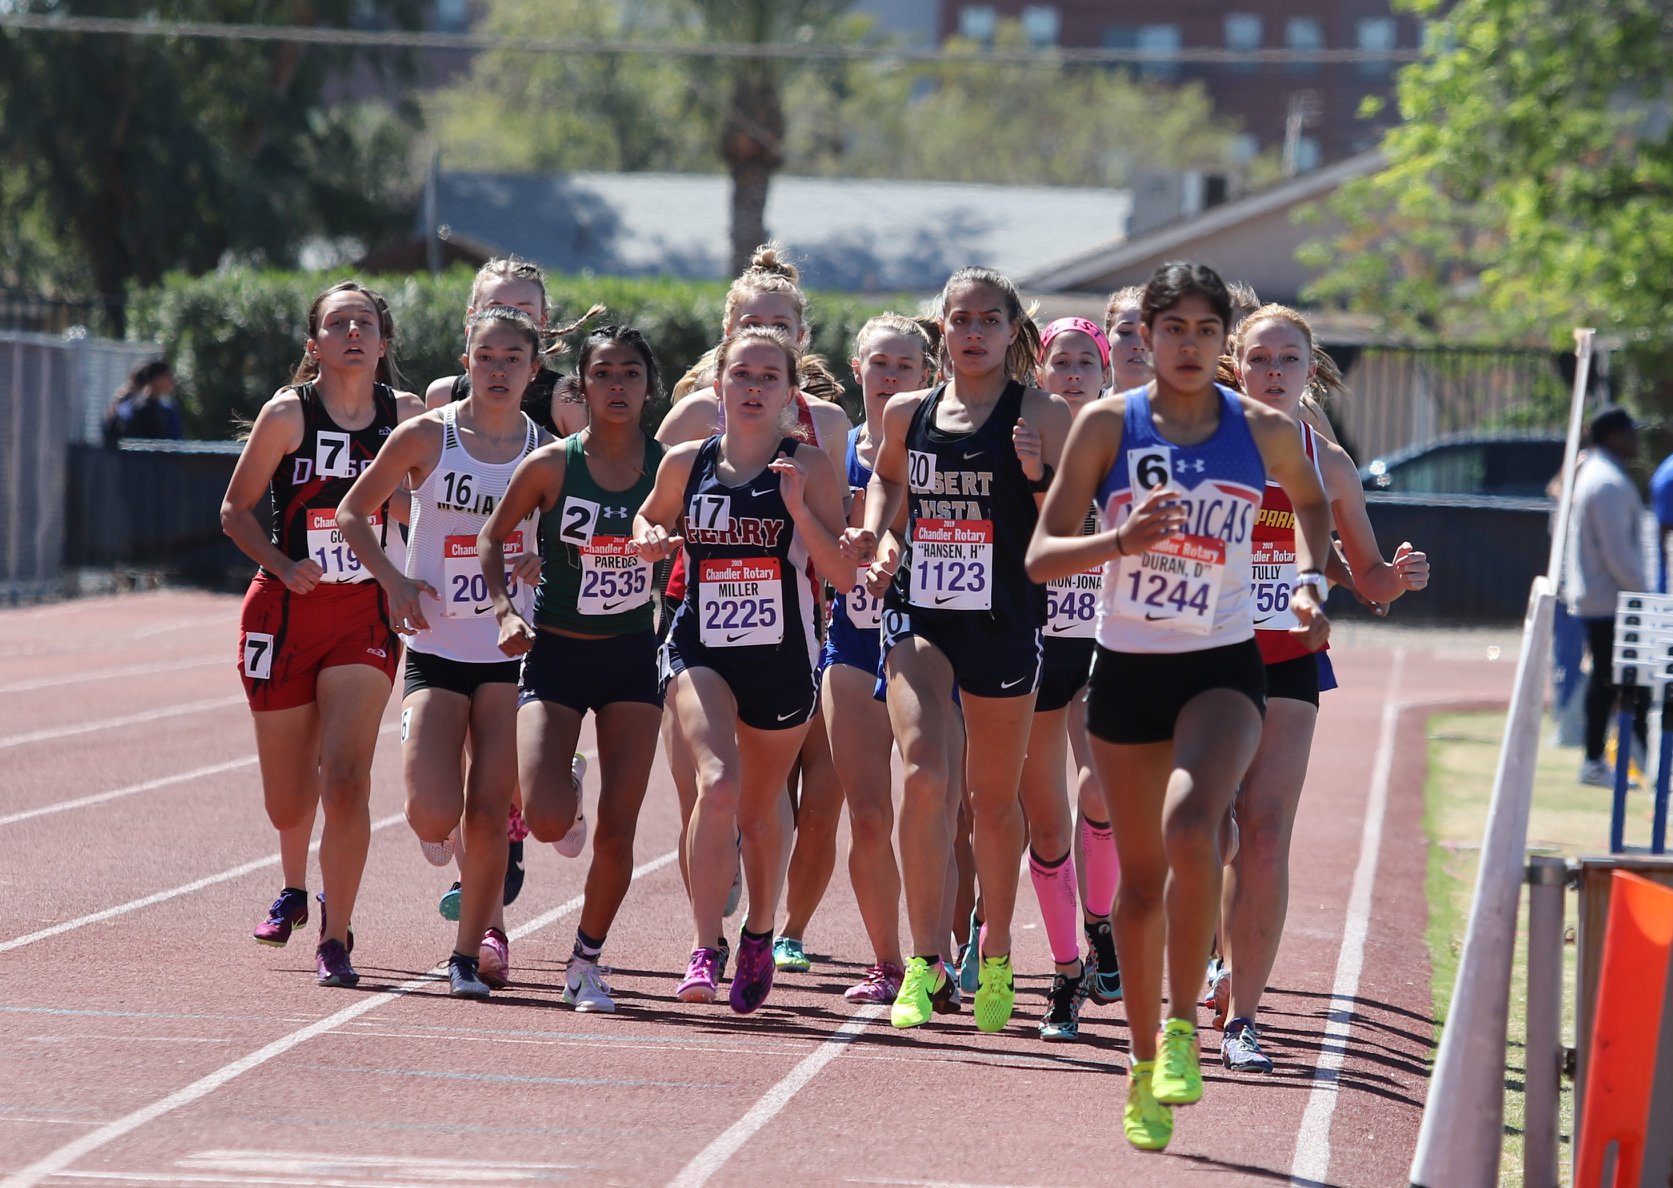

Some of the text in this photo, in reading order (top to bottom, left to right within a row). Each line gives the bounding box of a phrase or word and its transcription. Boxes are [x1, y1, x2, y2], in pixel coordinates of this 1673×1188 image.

[320, 438, 344, 470] 7
[910, 452, 929, 487] 20
[911, 471, 993, 496] SERT
[1136, 454, 1168, 490] 6
[443, 471, 473, 505] 16
[562, 505, 591, 541] 2
[692, 498, 726, 529] 17
[1126, 499, 1252, 544] RICAS
[330, 530, 346, 544] GO
[918, 526, 986, 542] Chandler Rotary
[315, 545, 362, 574] 119
[595, 556, 638, 569] PAREDES
[1182, 542, 1219, 563] Rotary
[582, 567, 647, 598] 2535
[706, 567, 774, 581] Chandler Rotary
[917, 560, 986, 592] 1123
[1252, 565, 1281, 580] TULLY
[718, 582, 759, 598] MILLER
[1128, 570, 1210, 616] 1244
[705, 598, 777, 630] 2225
[883, 610, 903, 635] 0
[247, 639, 269, 672] 7
